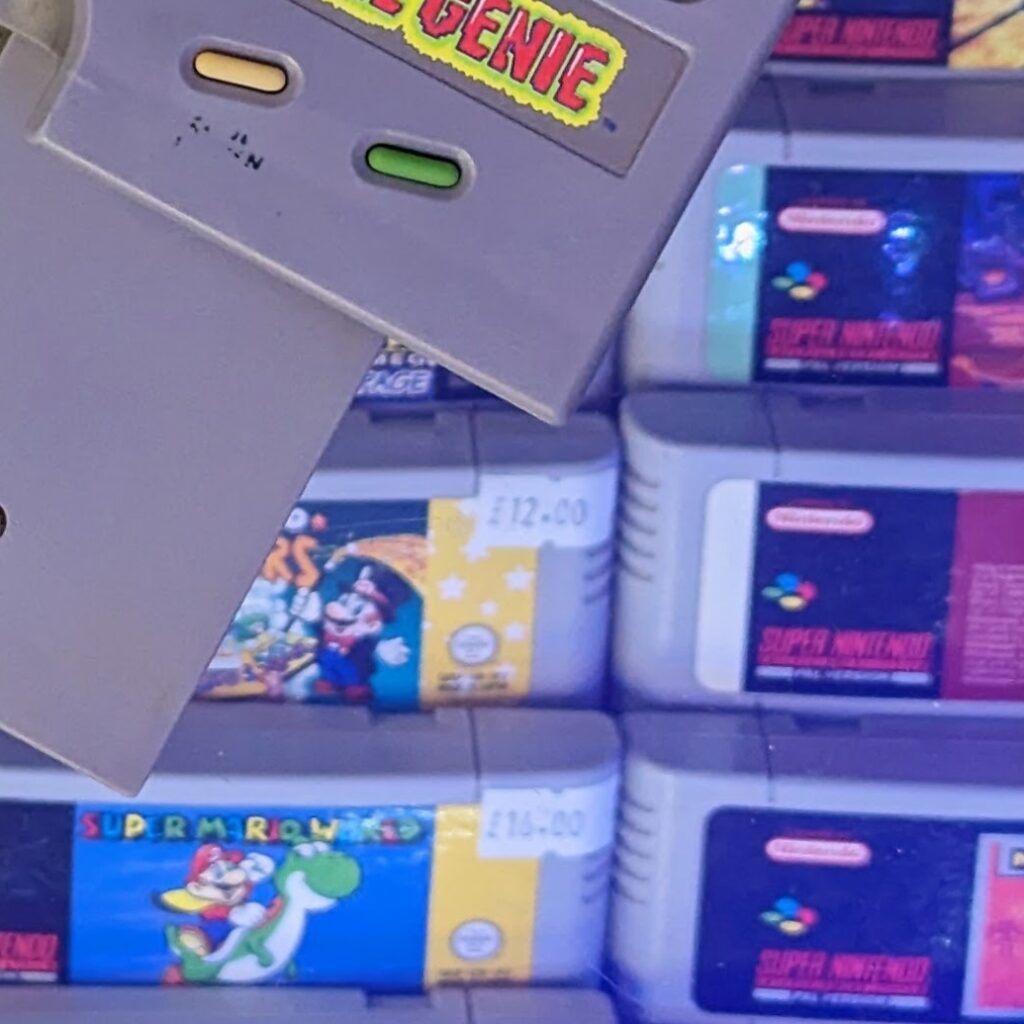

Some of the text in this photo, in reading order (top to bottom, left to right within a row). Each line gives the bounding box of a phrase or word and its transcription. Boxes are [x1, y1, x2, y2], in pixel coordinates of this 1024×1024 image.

[488, 495, 588, 527] £12.00
[762, 627, 933, 660] SUPER NINTENDO
[80, 811, 188, 842] SUPER
[196, 813, 305, 843] MARIO
